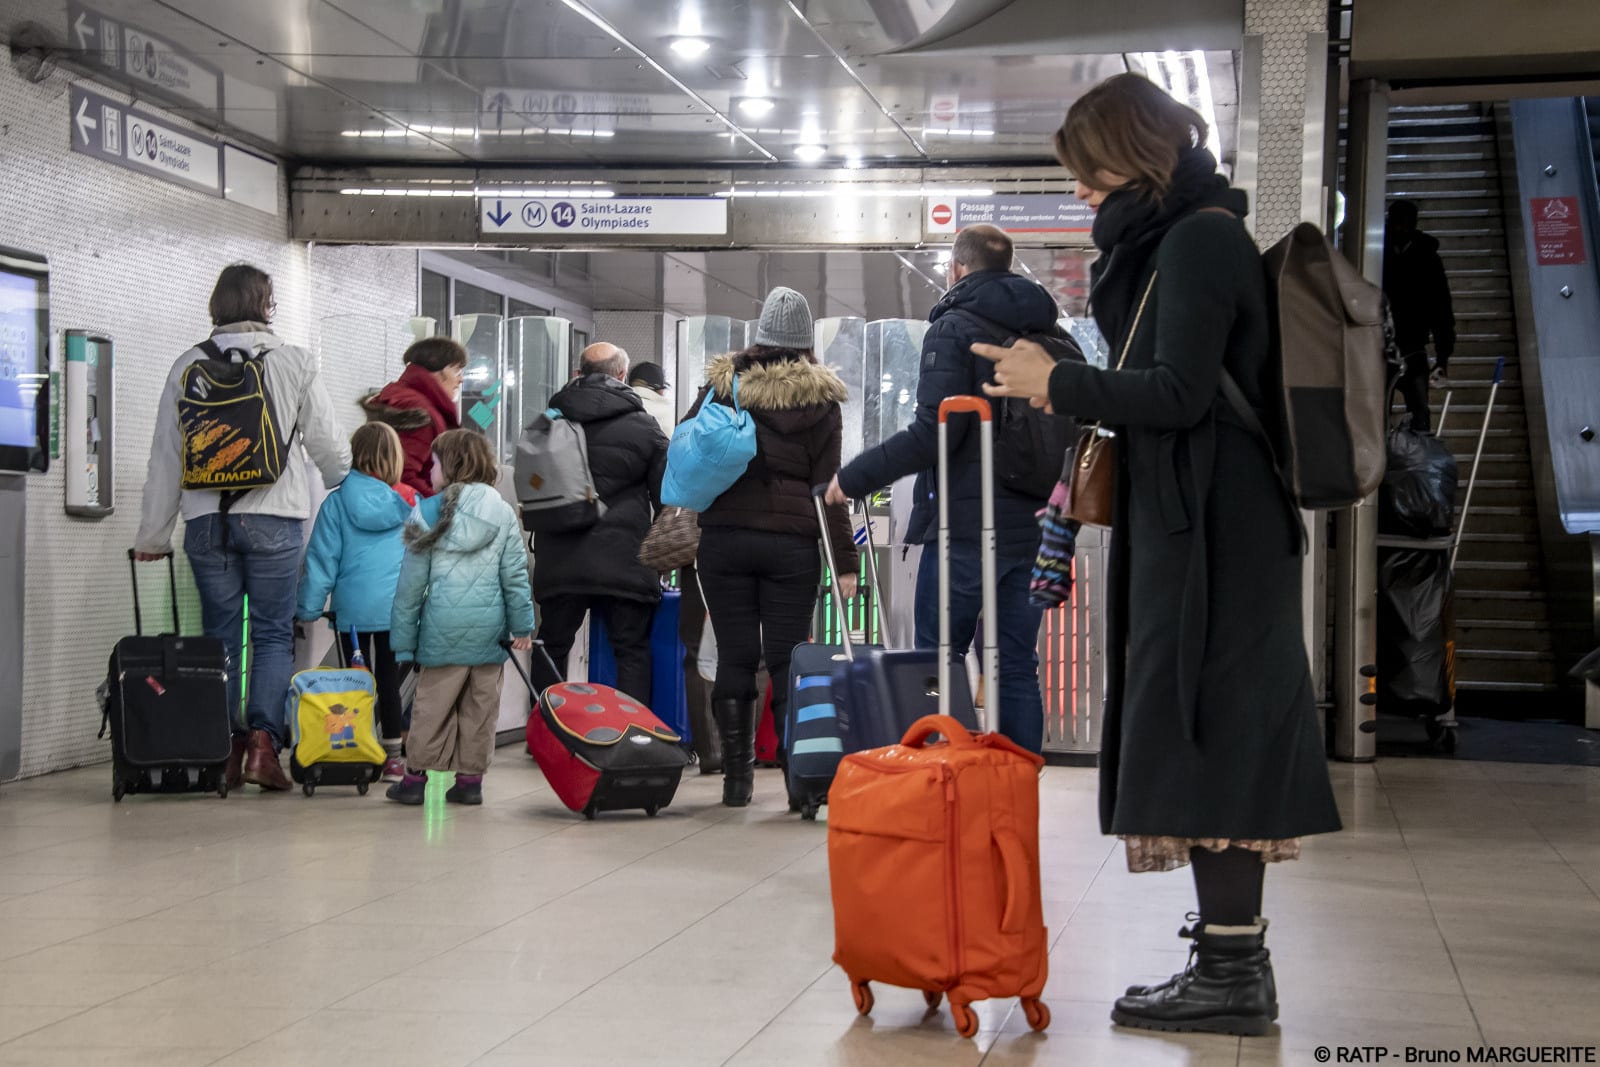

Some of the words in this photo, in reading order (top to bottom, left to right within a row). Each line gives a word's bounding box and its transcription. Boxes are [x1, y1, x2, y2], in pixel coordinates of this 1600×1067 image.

[159, 134, 193, 156] Saint-Lazare
[159, 151, 190, 172] Olympiades
[552, 206, 574, 223] 14
[581, 203, 652, 214] Saint-Lazare
[960, 202, 995, 213] Passage
[581, 217, 649, 230] Olympiades
[960, 212, 994, 222] interdit
